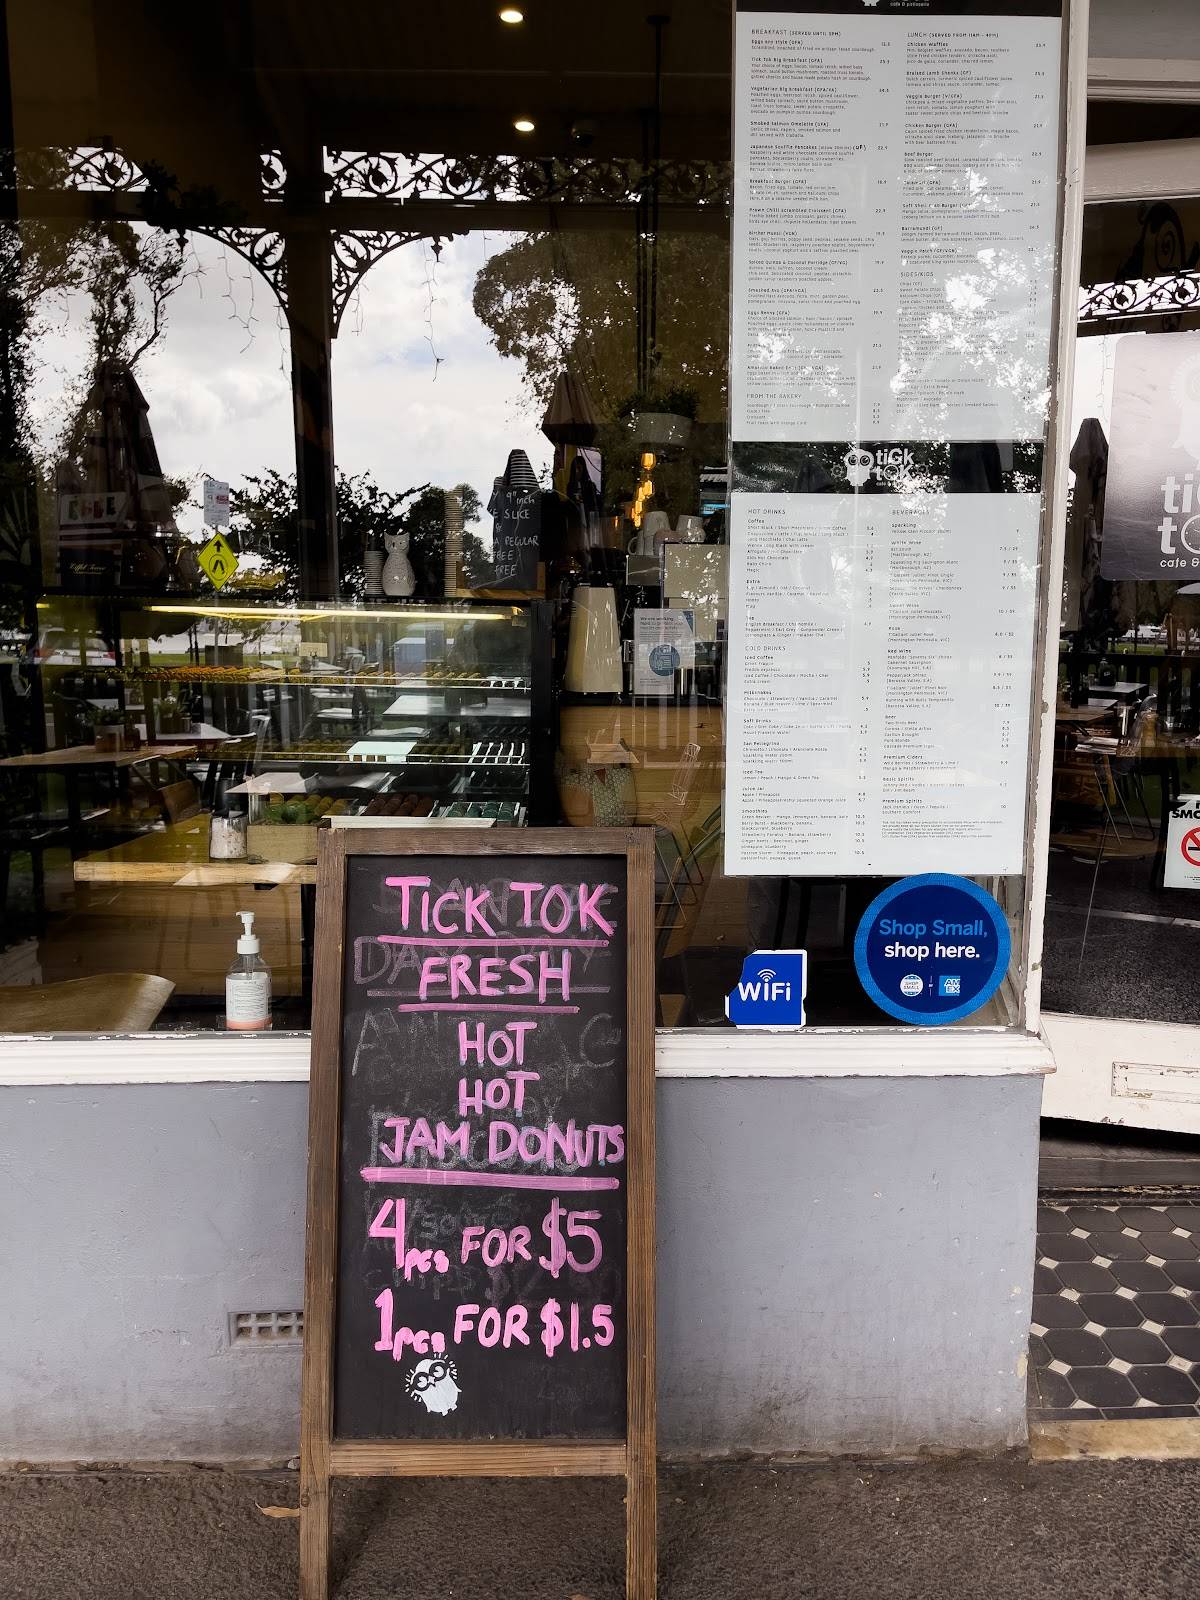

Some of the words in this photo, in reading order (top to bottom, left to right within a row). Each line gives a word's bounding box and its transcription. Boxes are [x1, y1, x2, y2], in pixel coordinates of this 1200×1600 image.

[504, 508, 530, 520] SLICE
[385, 876, 496, 936] TICK
[510, 882, 614, 936] TOK
[879, 919, 927, 938] Shop
[932, 920, 988, 938] Small,
[884, 942, 930, 961] shop
[934, 942, 980, 958] here.
[419, 950, 572, 1004] FRESH
[458, 1021, 538, 1067] HOT
[458, 1070, 540, 1118] HOT
[380, 1116, 470, 1164] JAM
[488, 1118, 624, 1168] DONUTS
[461, 1225, 532, 1268] FOR
[538, 1196, 603, 1279] $5
[453, 1304, 530, 1348] FOR
[540, 1298, 614, 1358] $1.5
